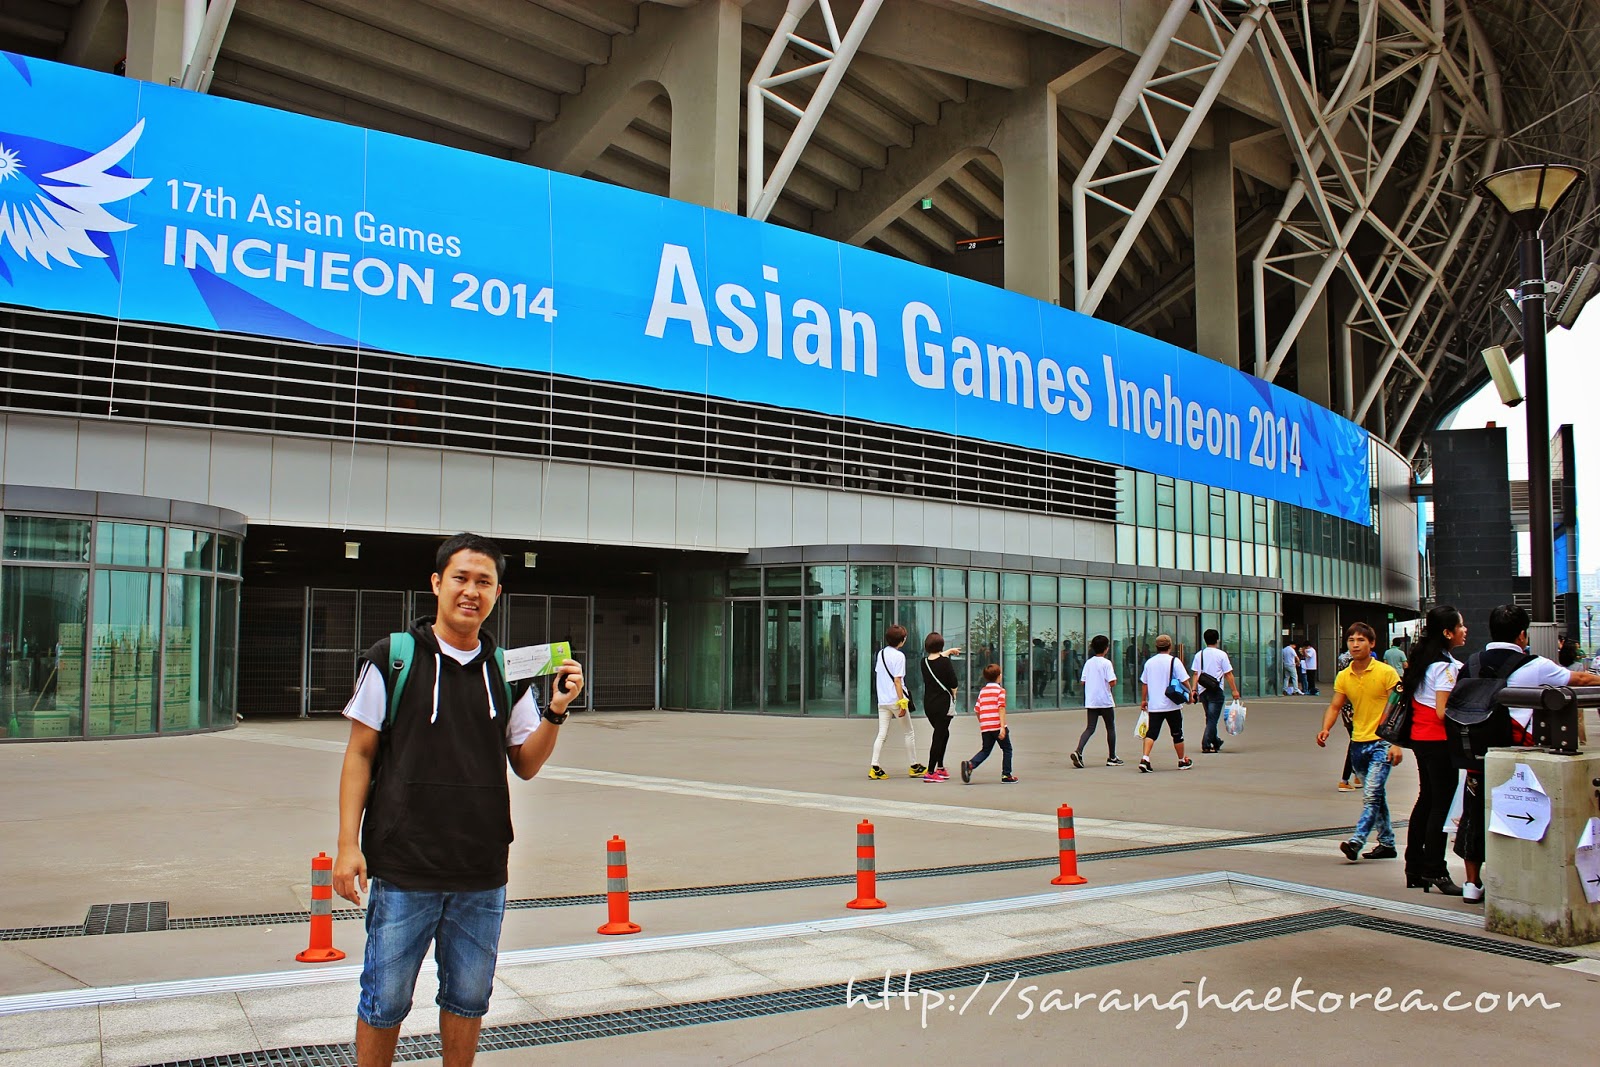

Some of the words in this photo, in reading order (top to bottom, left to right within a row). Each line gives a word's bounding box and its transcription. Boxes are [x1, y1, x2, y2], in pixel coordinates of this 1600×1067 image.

[167, 178, 237, 220] 17th
[247, 193, 343, 238] Asian
[354, 211, 462, 258] Games
[163, 225, 435, 305] INCHEON
[450, 272, 558, 323] 2014
[644, 242, 878, 378] Asian
[902, 301, 1093, 421] Games
[1102, 354, 1241, 461] Incheon
[1248, 405, 1302, 478] 2014
